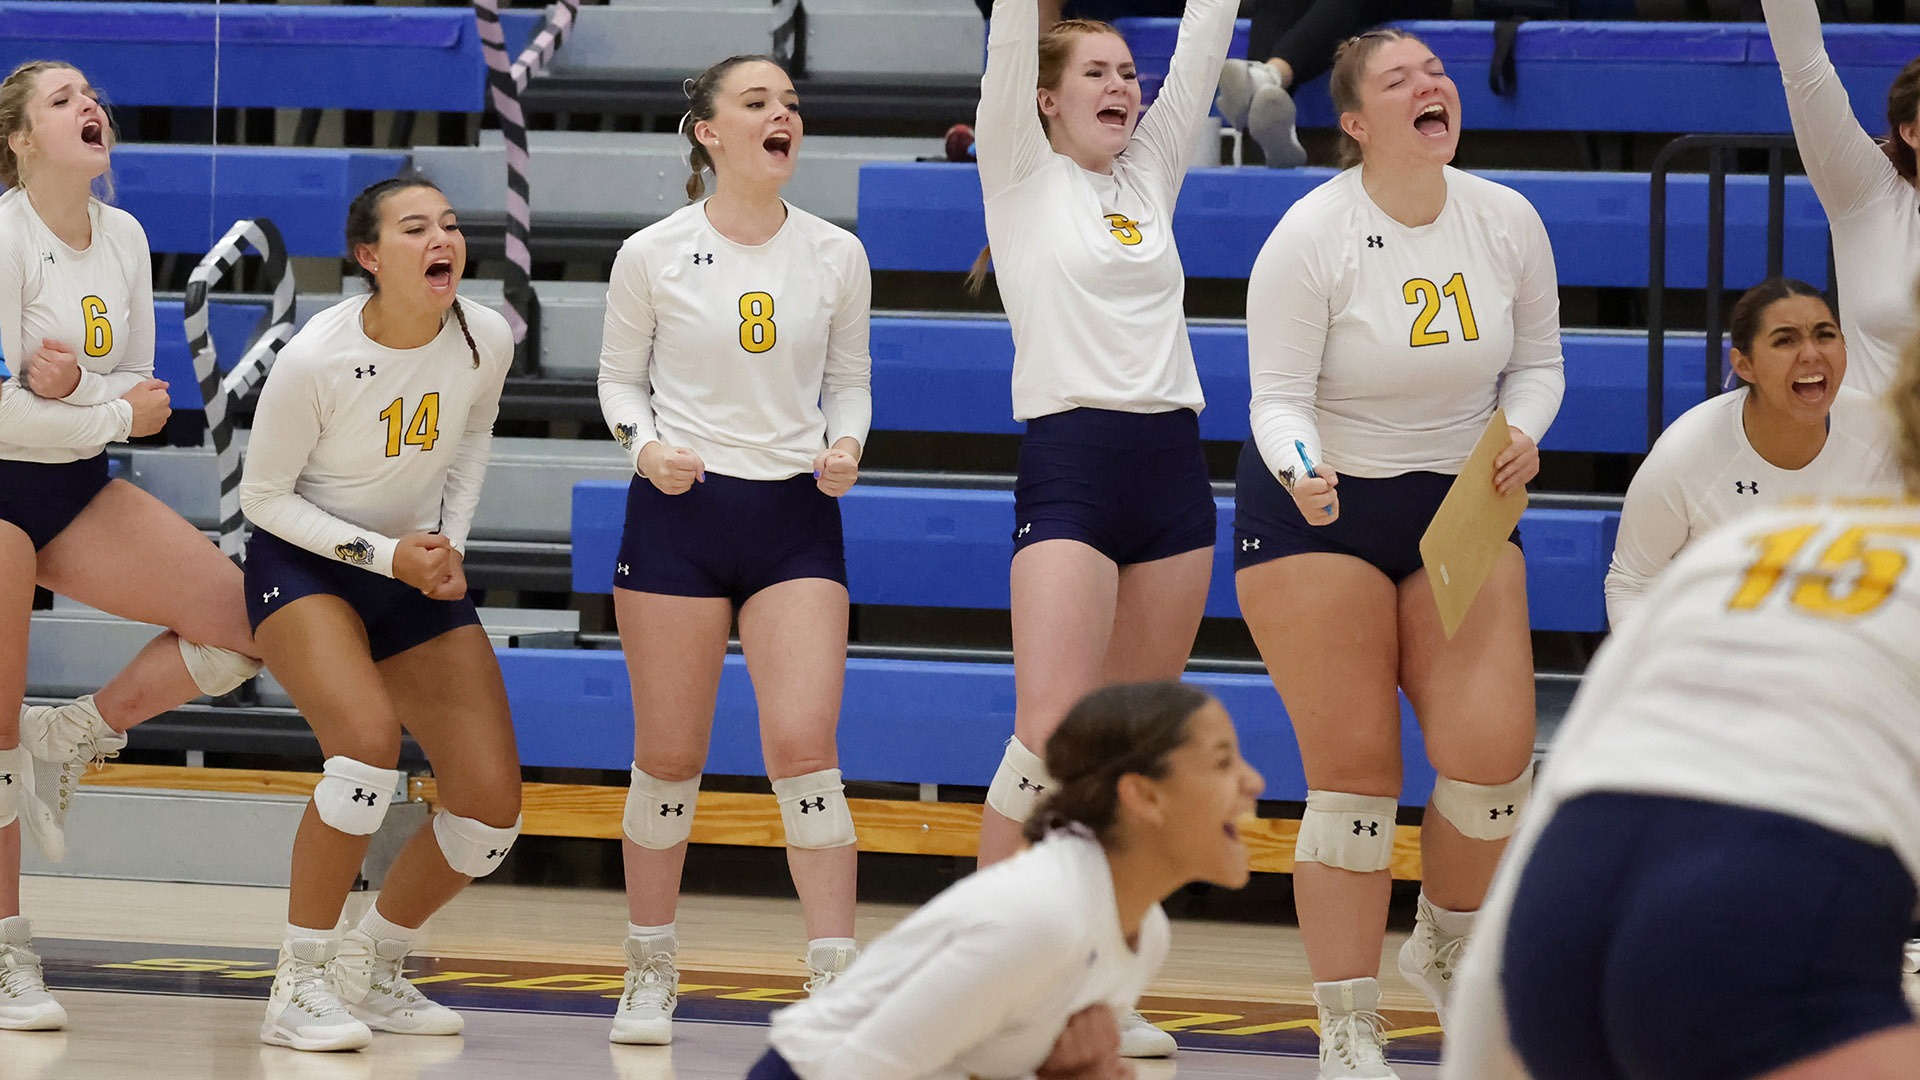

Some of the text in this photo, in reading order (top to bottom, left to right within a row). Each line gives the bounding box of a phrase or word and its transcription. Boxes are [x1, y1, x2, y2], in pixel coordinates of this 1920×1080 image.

[81, 295, 113, 357] 6
[738, 291, 777, 354] 8
[1401, 272, 1479, 348] 21
[379, 391, 440, 458] 14
[1726, 523, 1920, 619] 15
